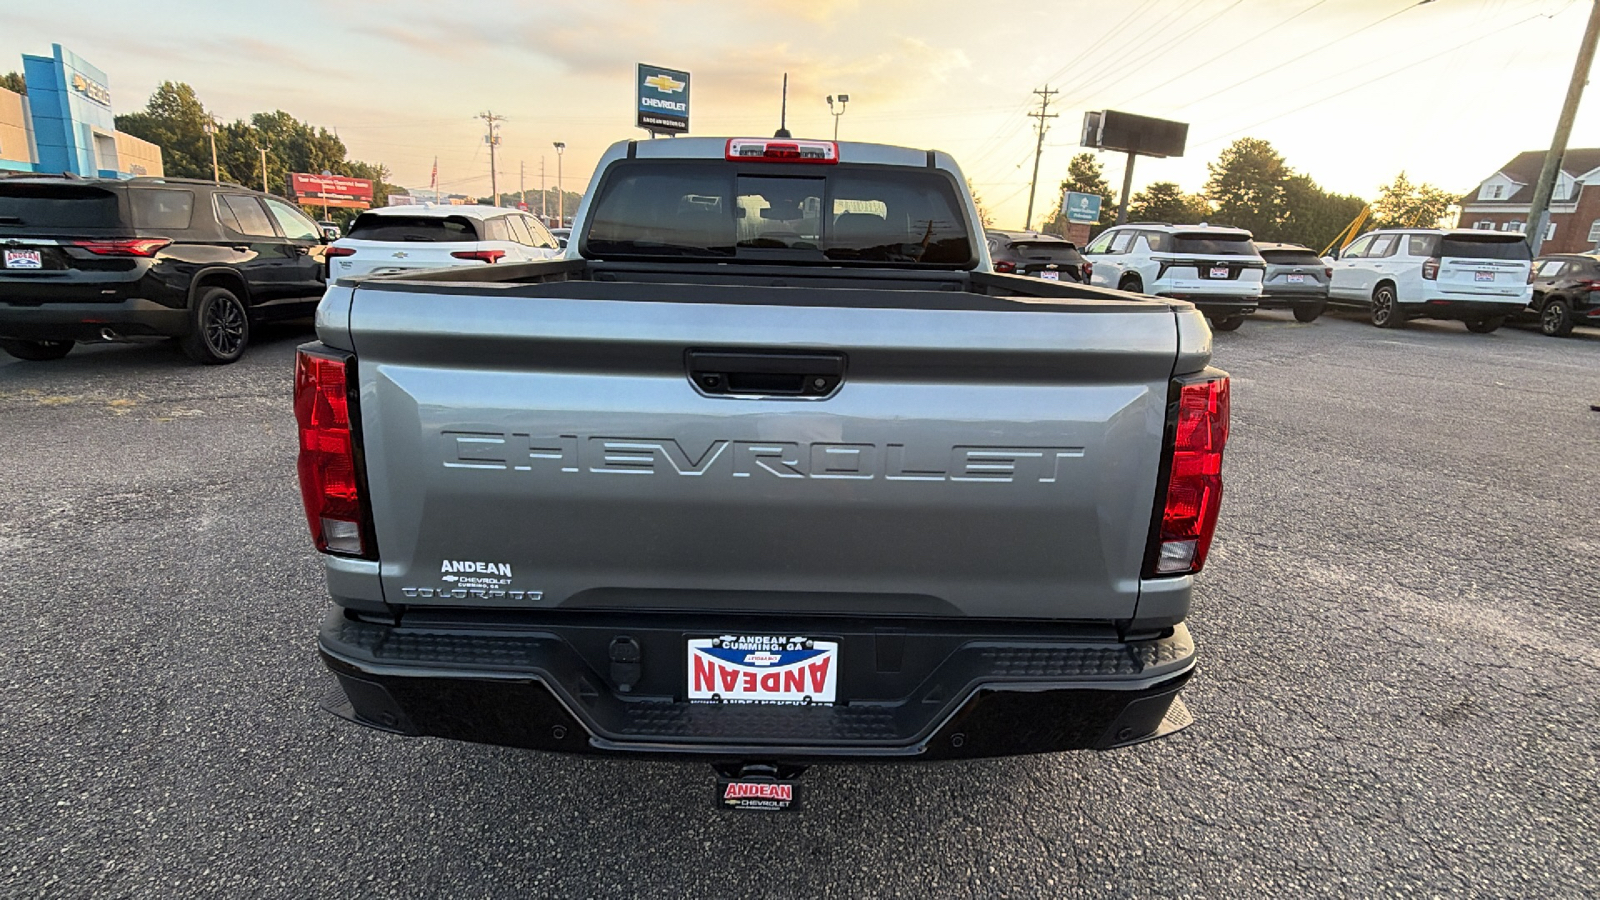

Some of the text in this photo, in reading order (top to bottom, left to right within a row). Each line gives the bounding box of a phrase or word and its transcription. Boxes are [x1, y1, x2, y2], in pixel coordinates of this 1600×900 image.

[641, 97, 686, 111] CHEVROLET
[643, 116, 662, 124] ANDEAN
[441, 430, 1085, 483] CHEVROLET
[441, 560, 512, 577] ANDEAN
[459, 576, 512, 584] CHEVROLET
[722, 642, 803, 651] CUMMING, GA
[738, 636, 787, 644] ANDEAN
[693, 652, 831, 694] ANDEAN
[724, 782, 792, 800] ANDEAN
